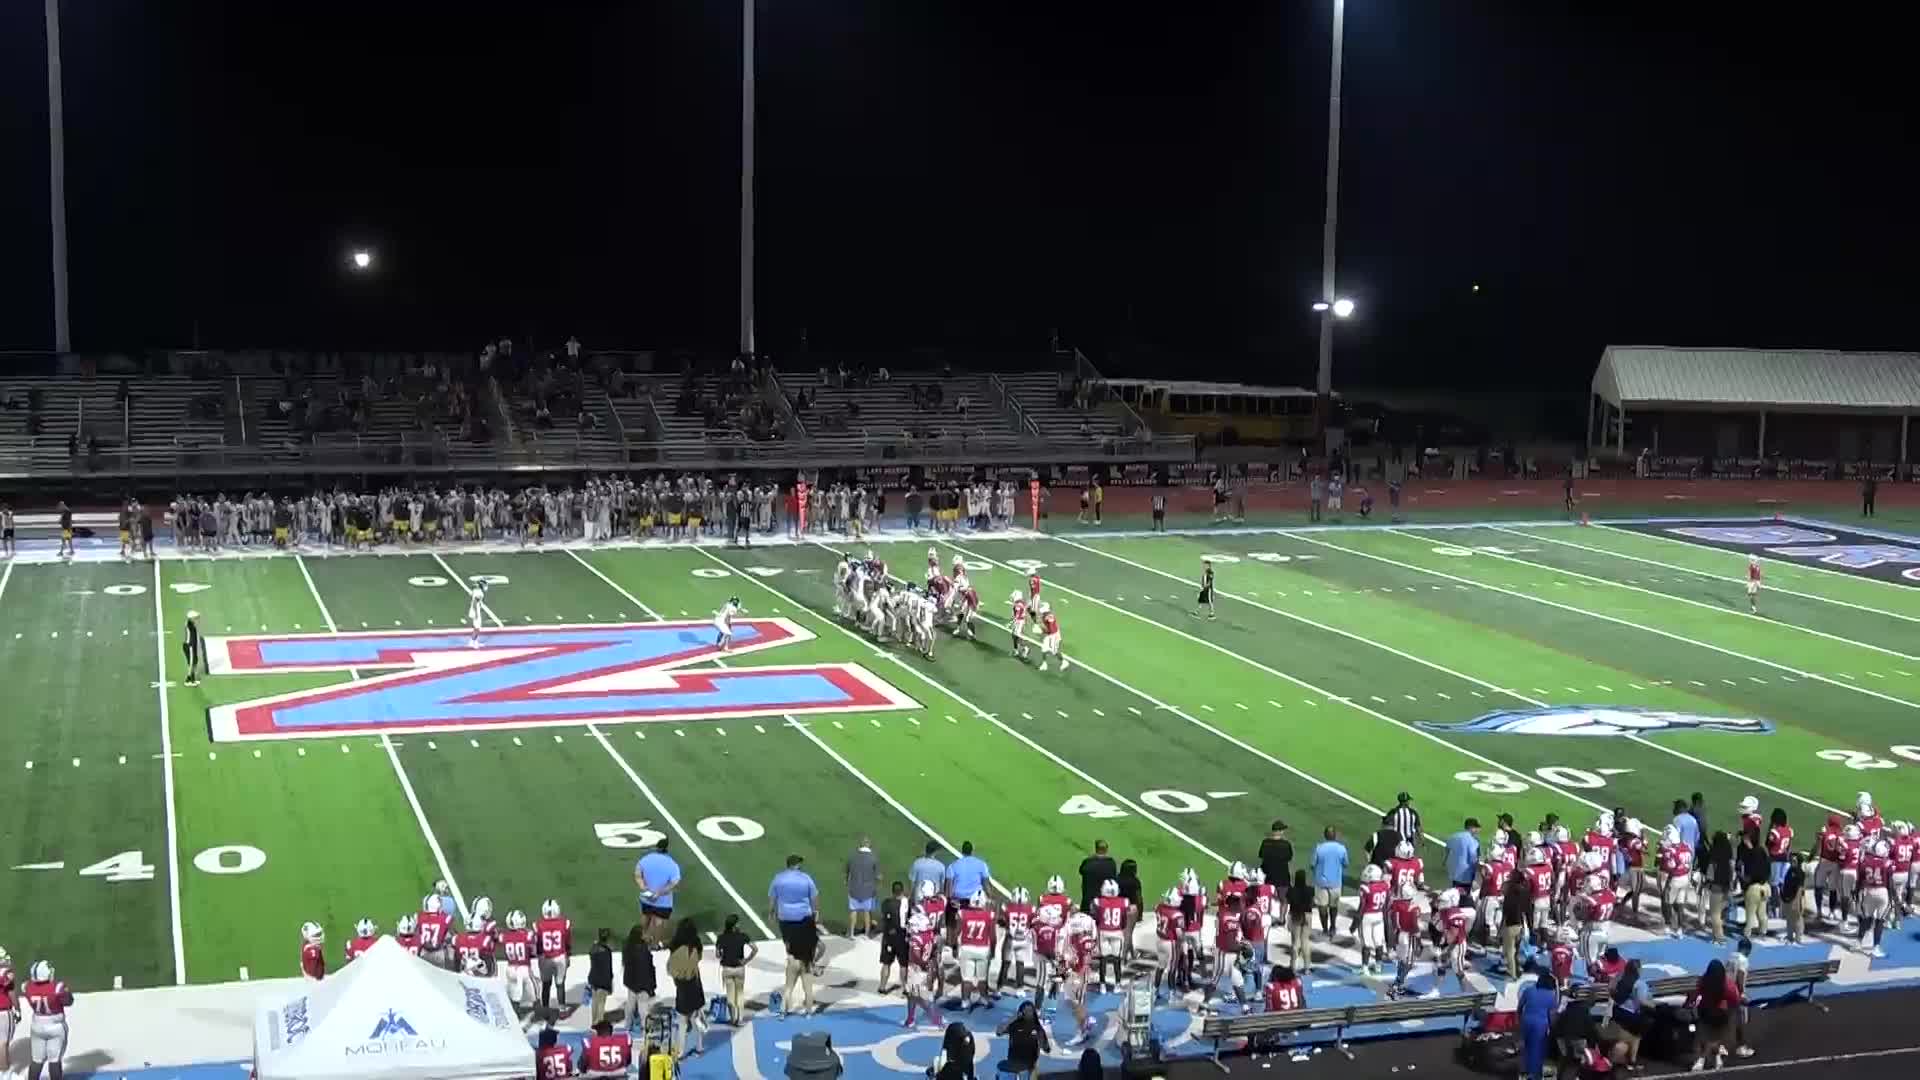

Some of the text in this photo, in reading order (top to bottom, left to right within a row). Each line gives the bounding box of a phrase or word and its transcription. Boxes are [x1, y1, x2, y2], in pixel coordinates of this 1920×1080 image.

[1455, 767, 1607, 793] 30
[1058, 790, 1208, 818] 40
[594, 816, 765, 848] 50
[79, 845, 267, 881] 40
[420, 923, 440, 946] 67
[542, 929, 561, 951] 63
[966, 919, 986, 939] 77
[542, 1053, 566, 1080] 35
